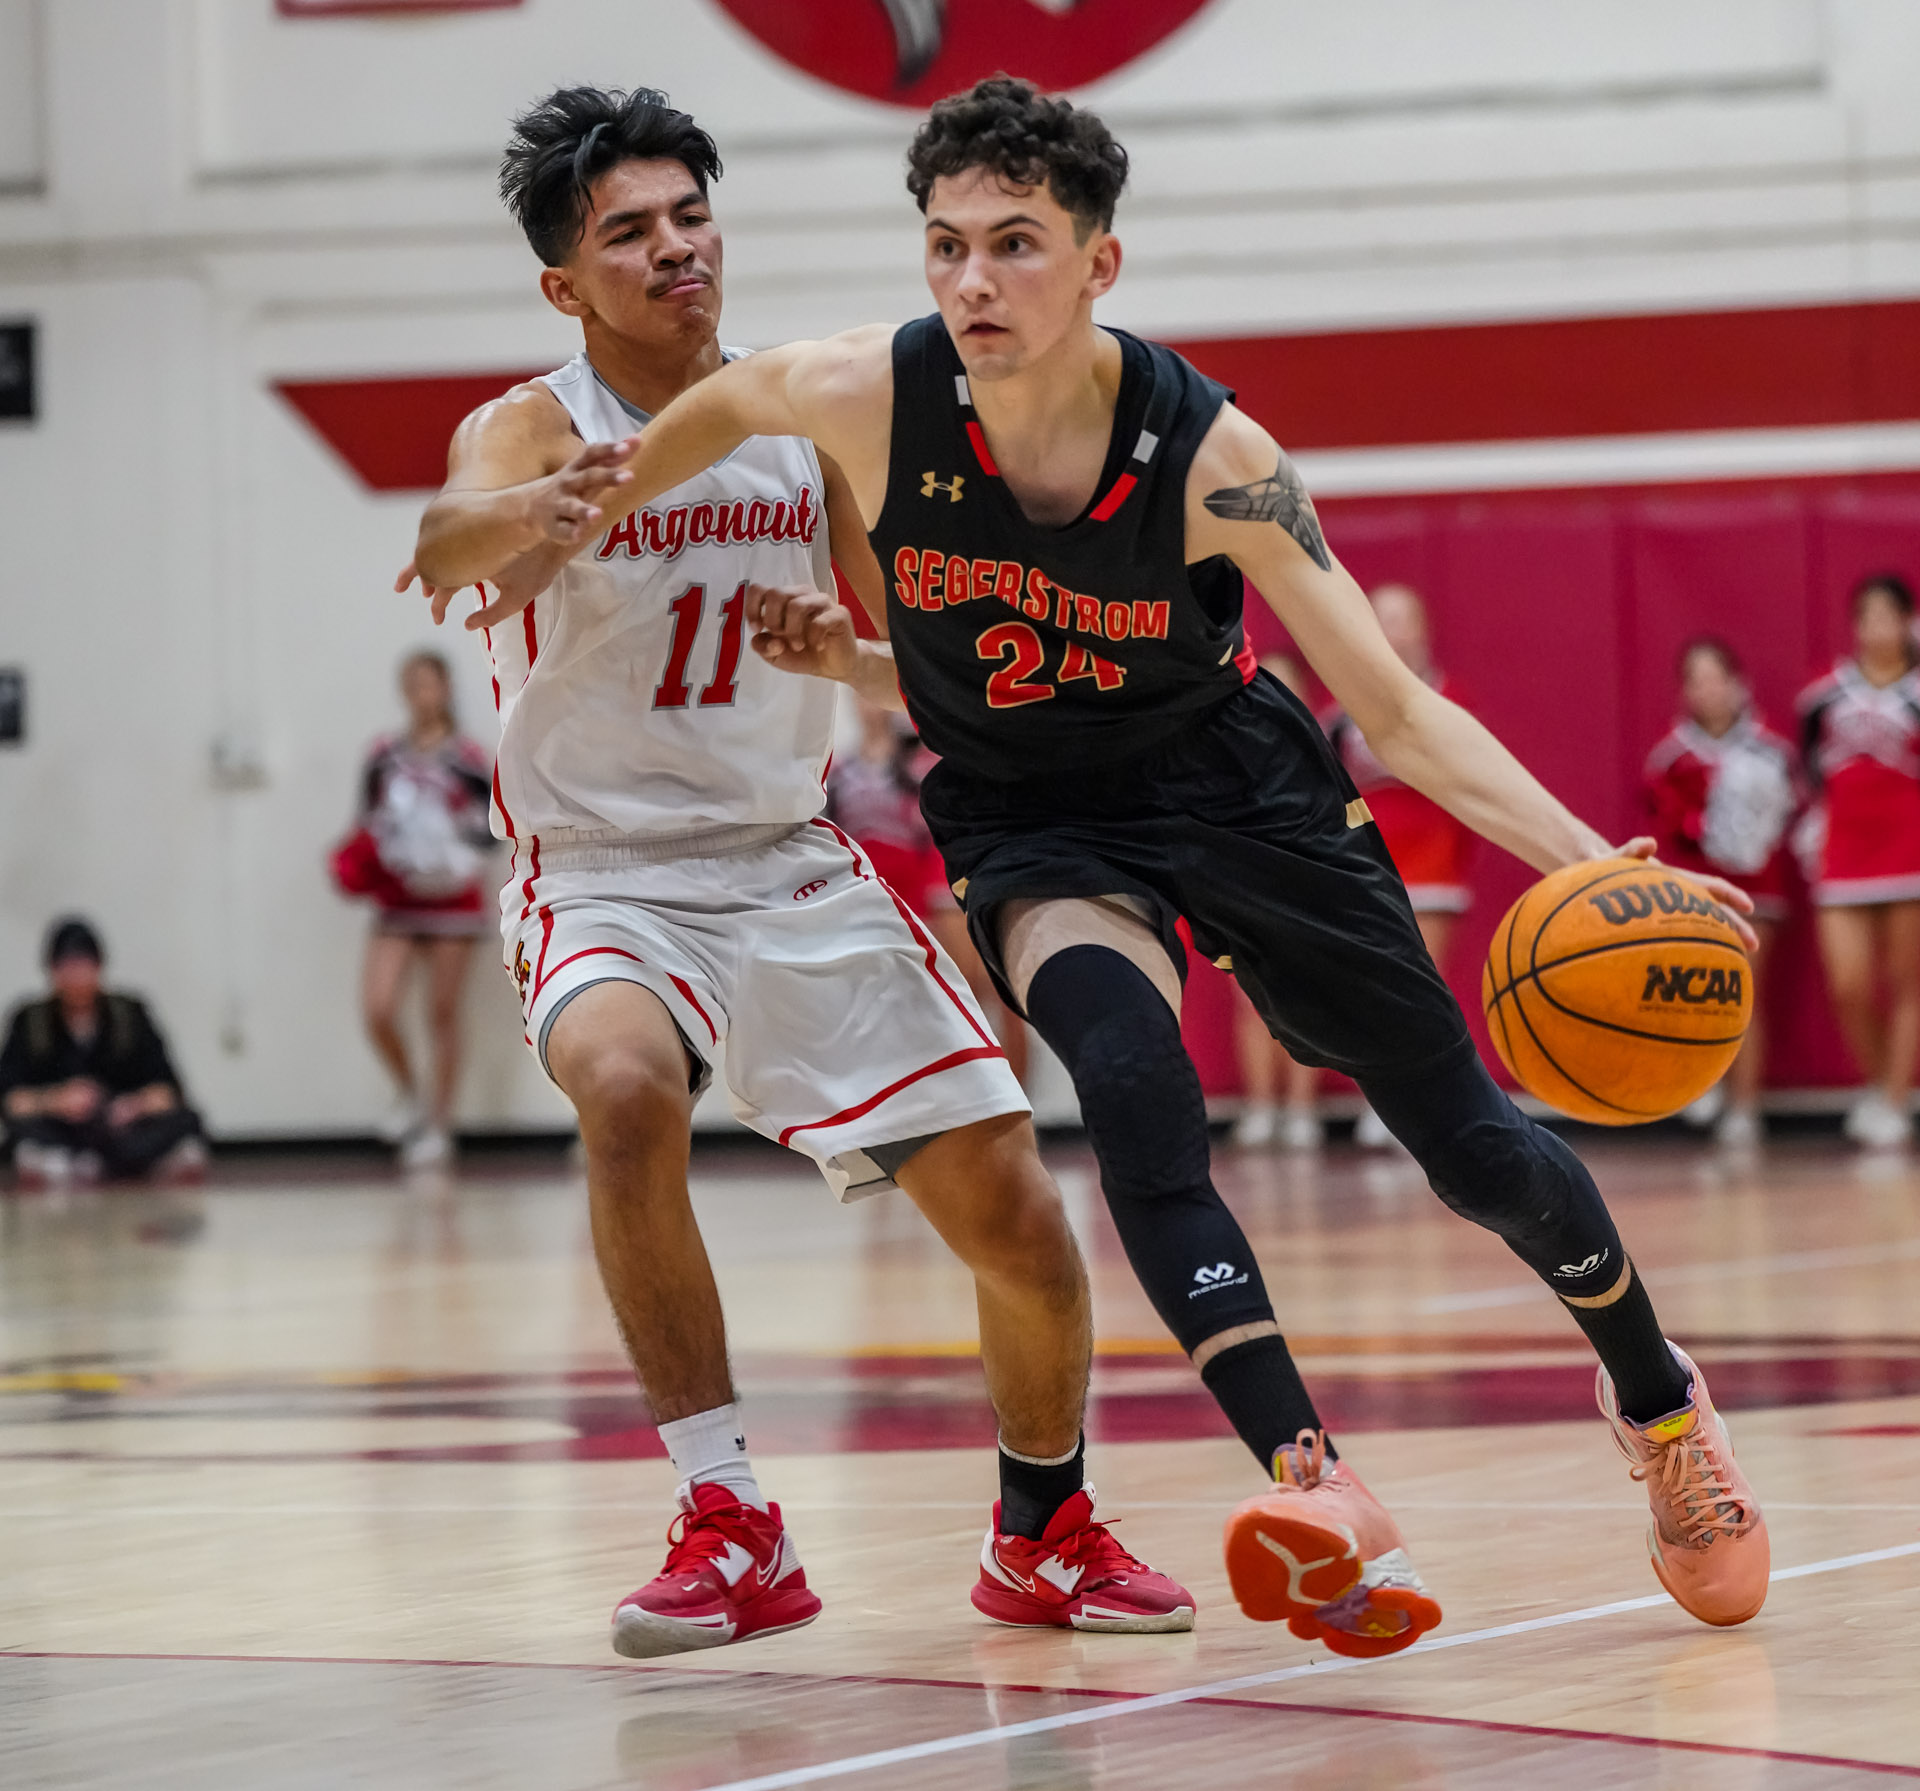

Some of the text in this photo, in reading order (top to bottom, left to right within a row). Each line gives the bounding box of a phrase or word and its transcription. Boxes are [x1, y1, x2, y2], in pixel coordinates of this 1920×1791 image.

[894, 546, 1170, 641] SEGERSTROM
[651, 579, 749, 711] 11
[975, 621, 1127, 709] 24
[1641, 965, 1742, 1007] NCAA
